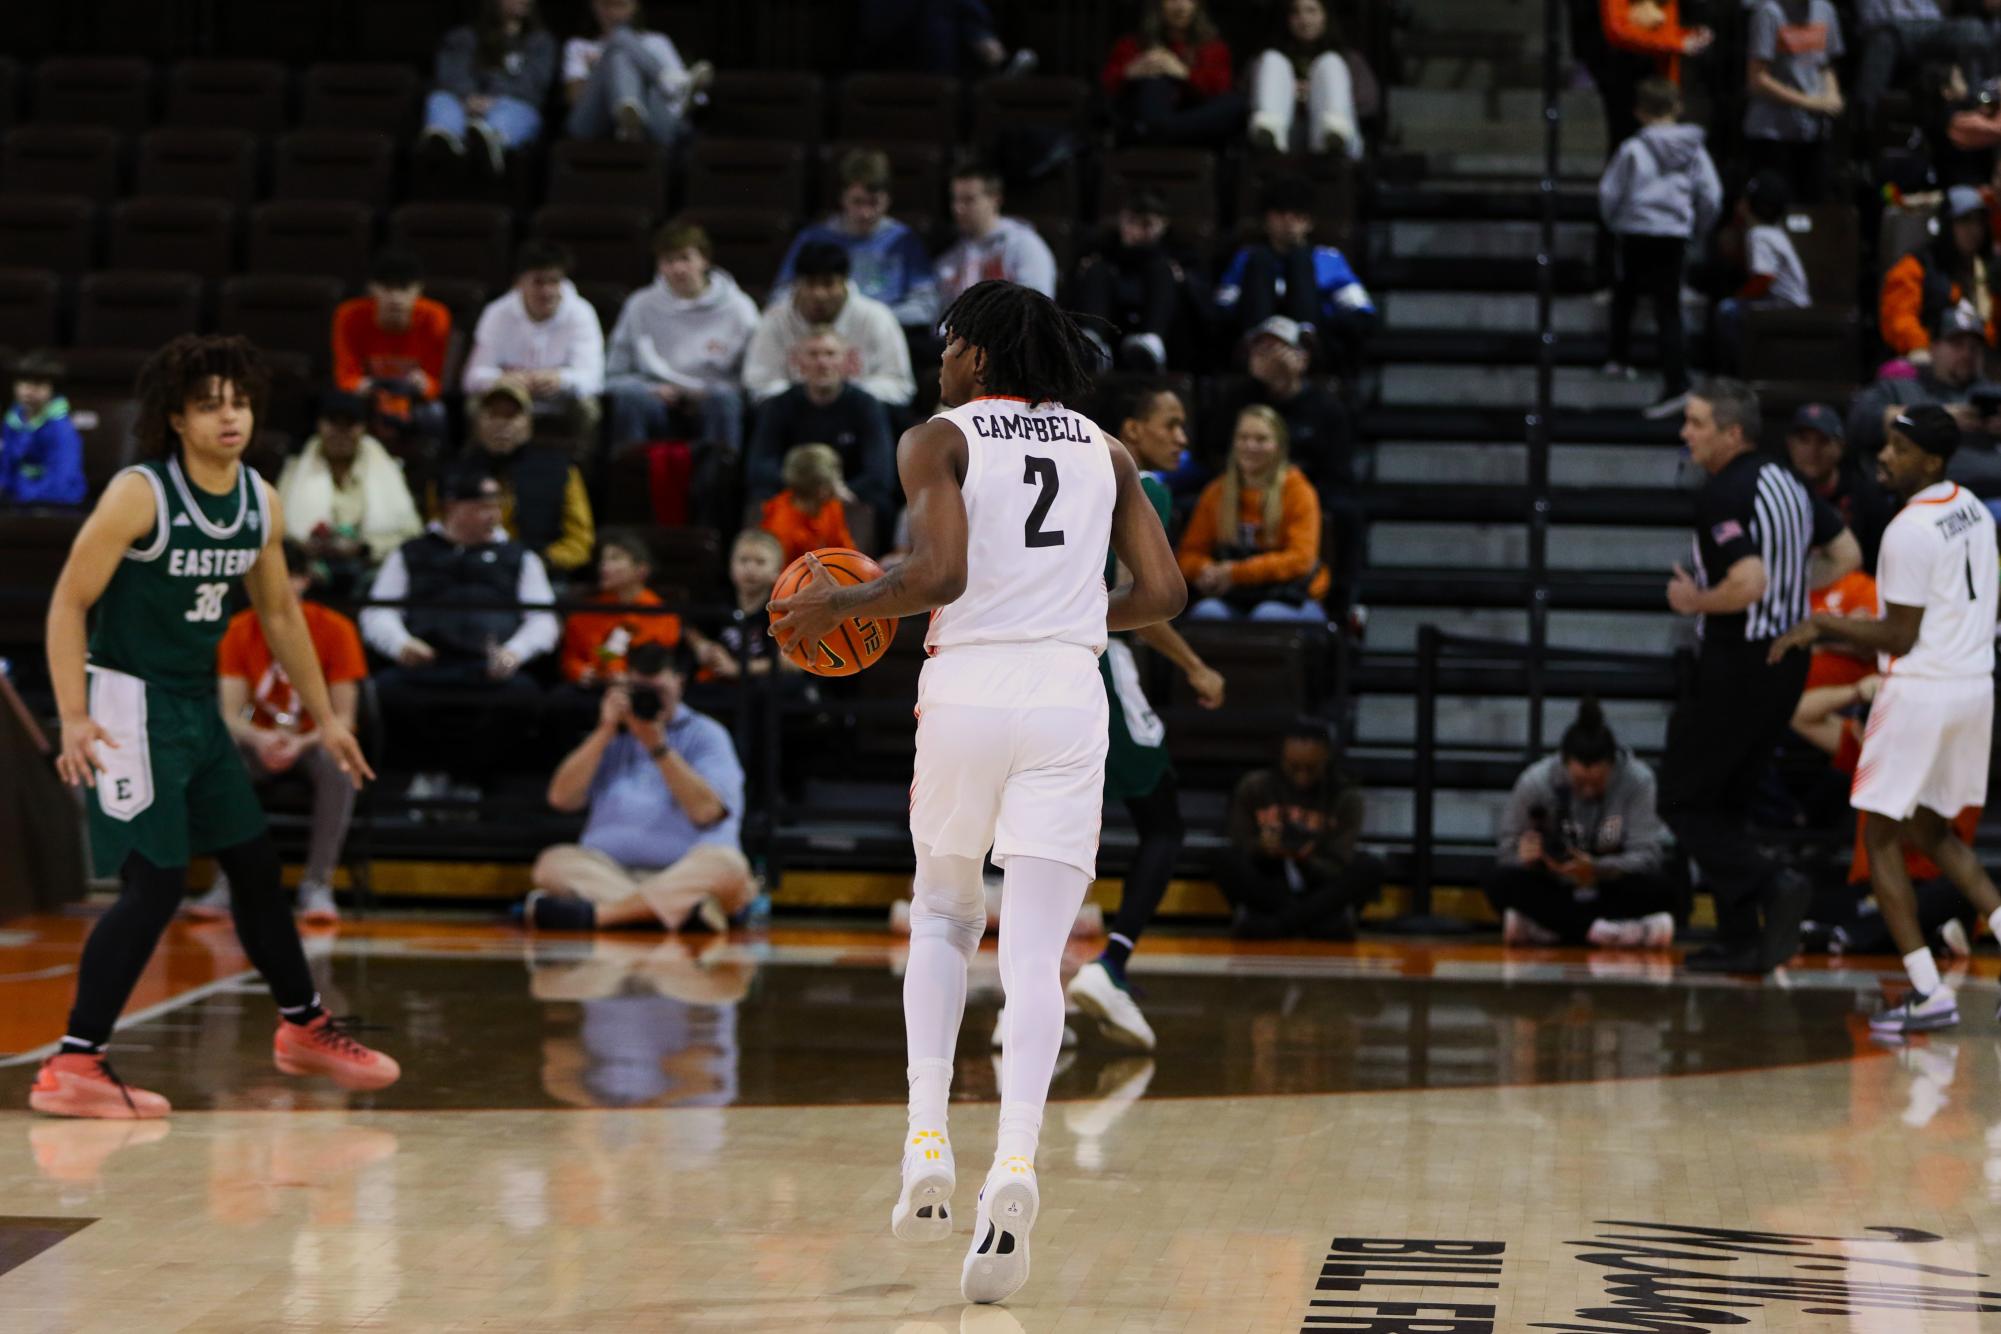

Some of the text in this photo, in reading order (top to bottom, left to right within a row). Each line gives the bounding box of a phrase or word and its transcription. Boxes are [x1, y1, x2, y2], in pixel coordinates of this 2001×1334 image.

[972, 413, 1091, 443] CAMPBELL
[1023, 454, 1064, 548] 2
[1964, 538, 1977, 601] 1
[116, 778, 131, 800] E
[1315, 1237, 1506, 1291] BILL
